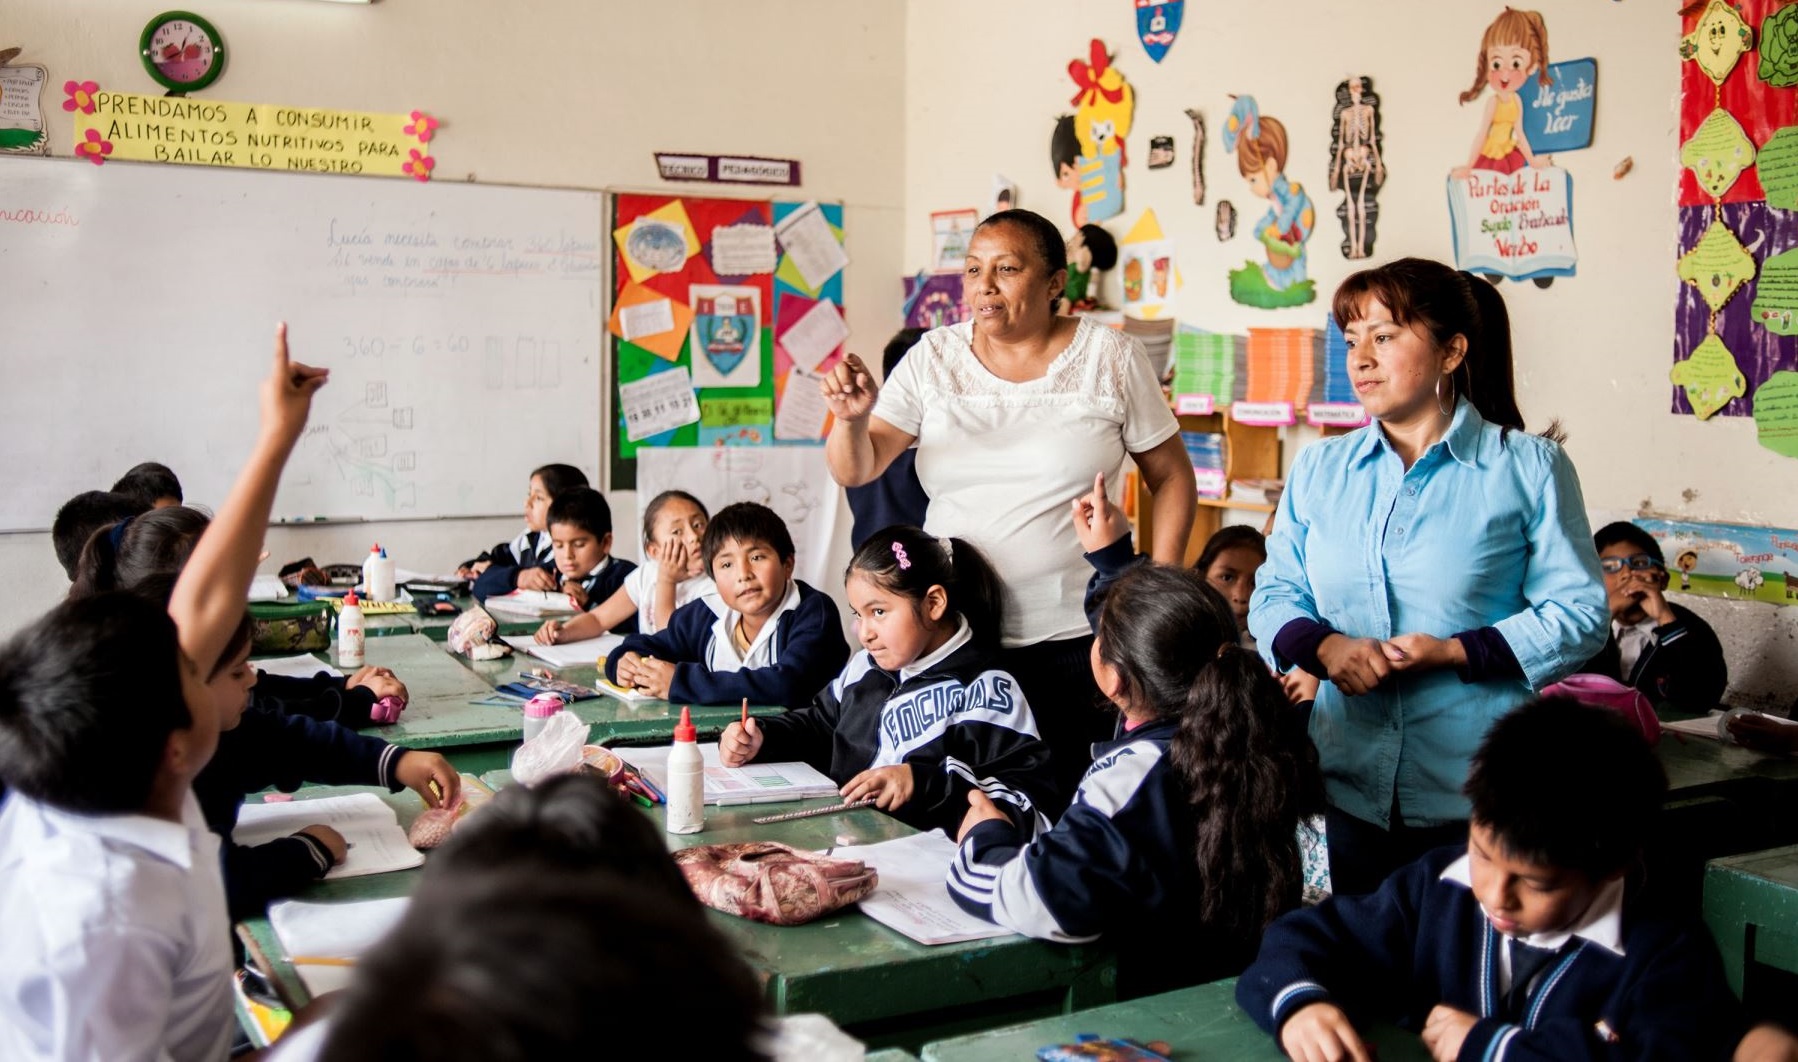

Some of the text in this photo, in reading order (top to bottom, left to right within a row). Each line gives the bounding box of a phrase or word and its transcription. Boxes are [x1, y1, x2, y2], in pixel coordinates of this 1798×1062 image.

[173, 22, 183, 31] 12
[1556, 77, 1593, 116] gusta
[246, 107, 258, 125] A
[276, 109, 375, 133] CONSUMIR
[107, 119, 400, 158] ALIMENTOS NUTRITIVOS PARA
[154, 143, 364, 174] BAILAR LO NUESTRO
[1468, 174, 1509, 199] Partes
[1512, 173, 1527, 195] de
[326, 215, 373, 248] Lucía
[1494, 234, 1539, 258] Verbo
[342, 335, 386, 360] 360
[412, 335, 426, 356] 6
[446, 331, 471, 353] 60
